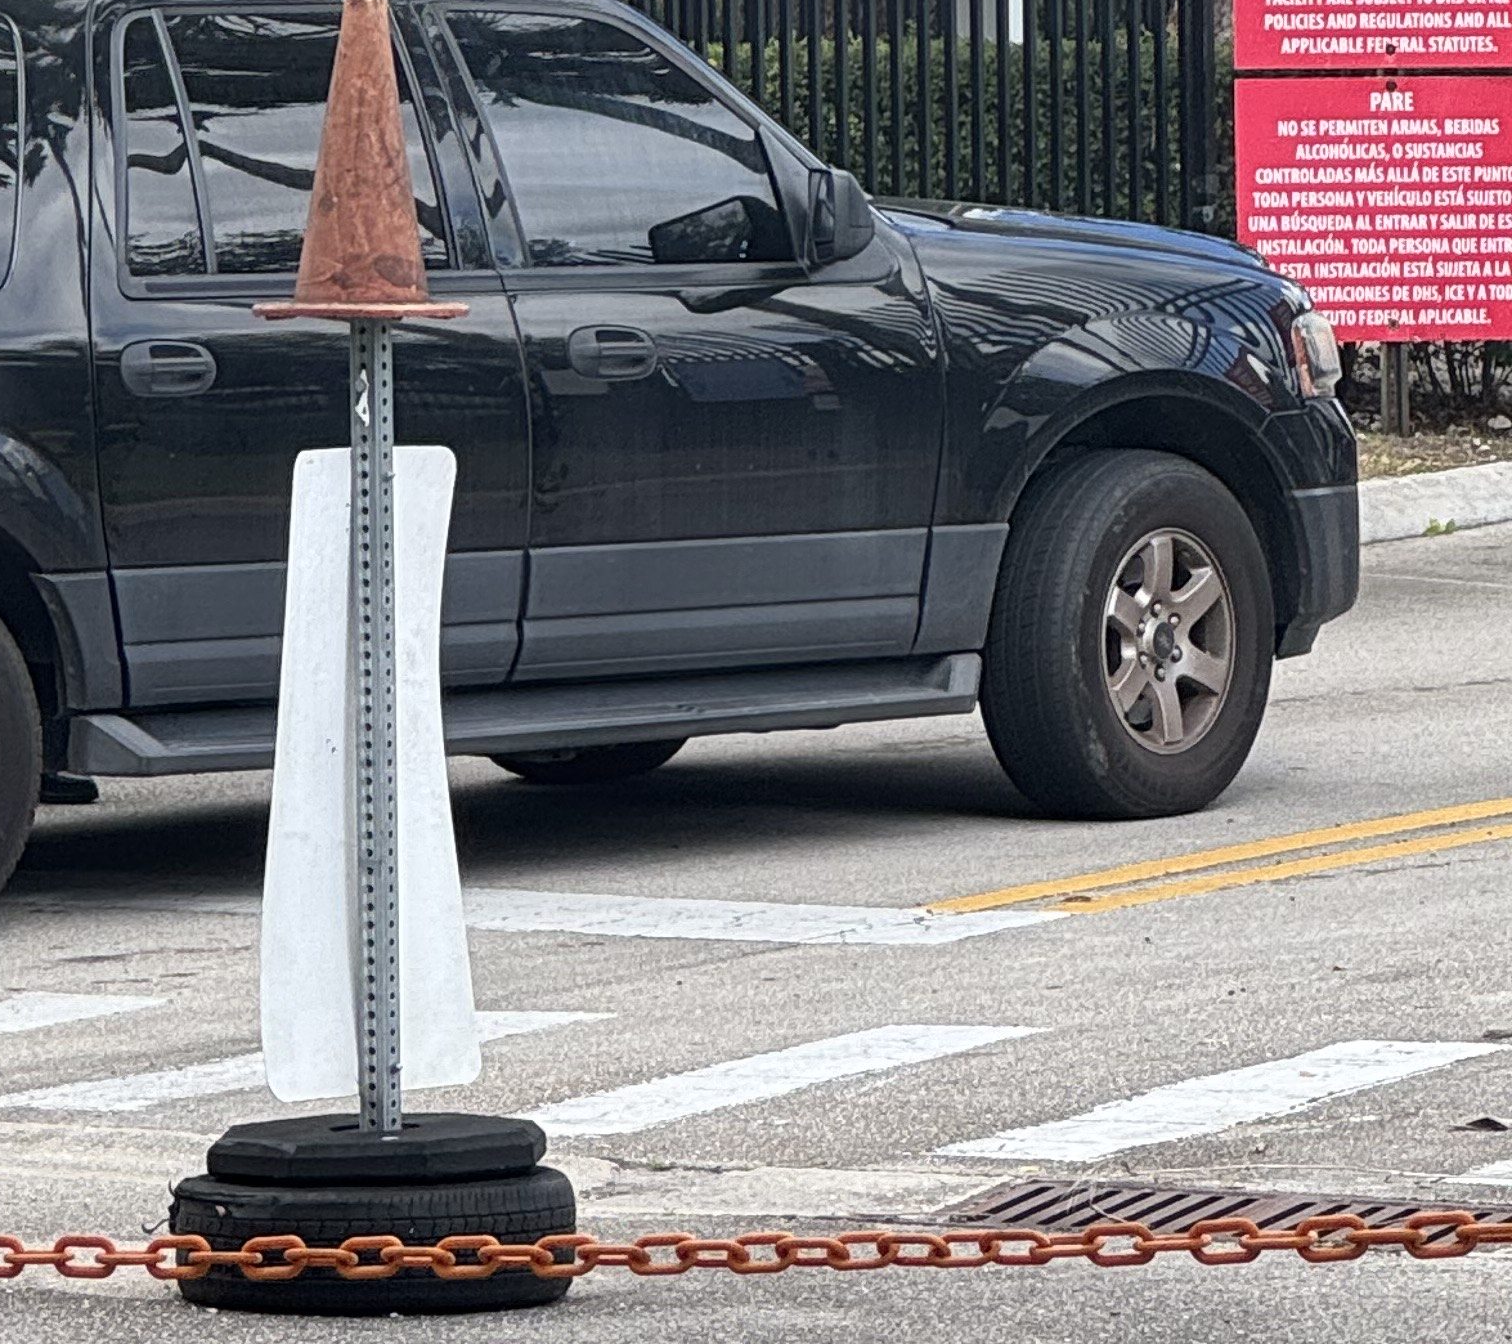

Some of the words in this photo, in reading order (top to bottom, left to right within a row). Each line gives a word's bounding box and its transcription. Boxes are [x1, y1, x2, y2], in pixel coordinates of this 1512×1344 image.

[1264, 12, 1324, 31] POLICIES
[1326, 12, 1356, 30] AND
[1360, 11, 1452, 30] REGULATIONS
[1454, 11, 1484, 29] AND
[1486, 11, 1511, 29] ALL
[1281, 36, 1363, 55] APPLICABLE
[1429, 35, 1498, 53] STATUTES.
[1370, 90, 1414, 112] PARE
[1278, 119, 1297, 137] NO
[1300, 119, 1317, 137] SE
[1320, 119, 1387, 137] PERMITEN
[1391, 118, 1441, 137] ARMAS,
[1444, 118, 1499, 136] BEBIDAS
[1295, 137, 1390, 162] ALCOHÓLICAS,
[1392, 142, 1403, 160] O
[1405, 142, 1483, 160] SUSTANCIAS
[1255, 166, 1352, 185] CONTROLADAS
[1355, 161, 1384, 184] MÁS
[1388, 161, 1420, 184] ALLÁ
[1423, 165, 1439, 183] DE
[1442, 165, 1471, 183] ESTE
[1252, 191, 1289, 209] TODA
[1292, 190, 1354, 208] PERSONA
[1356, 190, 1365, 208] Y
[1366, 184, 1431, 207] VEHÍCULO
[1434, 184, 1464, 207] ESTÁ
[1467, 189, 1511, 207] SUJETO
[1248, 215, 1278, 233] UNA
[1281, 210, 1353, 233] BÚSQUEDA
[1355, 214, 1372, 231] AL
[1376, 213, 1428, 231] ENTRAR
[1429, 213, 1437, 231] Y
[1440, 213, 1476, 231] SALIR
[1479, 213, 1495, 230] DE
[1257, 233, 1349, 256] INSTALACIÓN.
[1351, 237, 1386, 255] TODA
[1389, 237, 1450, 255] PERSONA
[1452, 237, 1477, 256] QUE
[1314, 255, 1401, 279] INSTALACIÓN
[1403, 255, 1434, 278] ESTÁ
[1436, 260, 1481, 278] SUJETA
[1482, 260, 1493, 278] A
[1495, 260, 1511, 278] LA
[1305, 285, 1389, 304] ENTACIONES
[1394, 285, 1410, 302] DE
[1413, 284, 1442, 304] DHS,
[1445, 284, 1464, 302] ICE
[1466, 284, 1477, 301] Y
[1477, 283, 1486, 301] A
[1418, 307, 1491, 326] APLICABLE.
